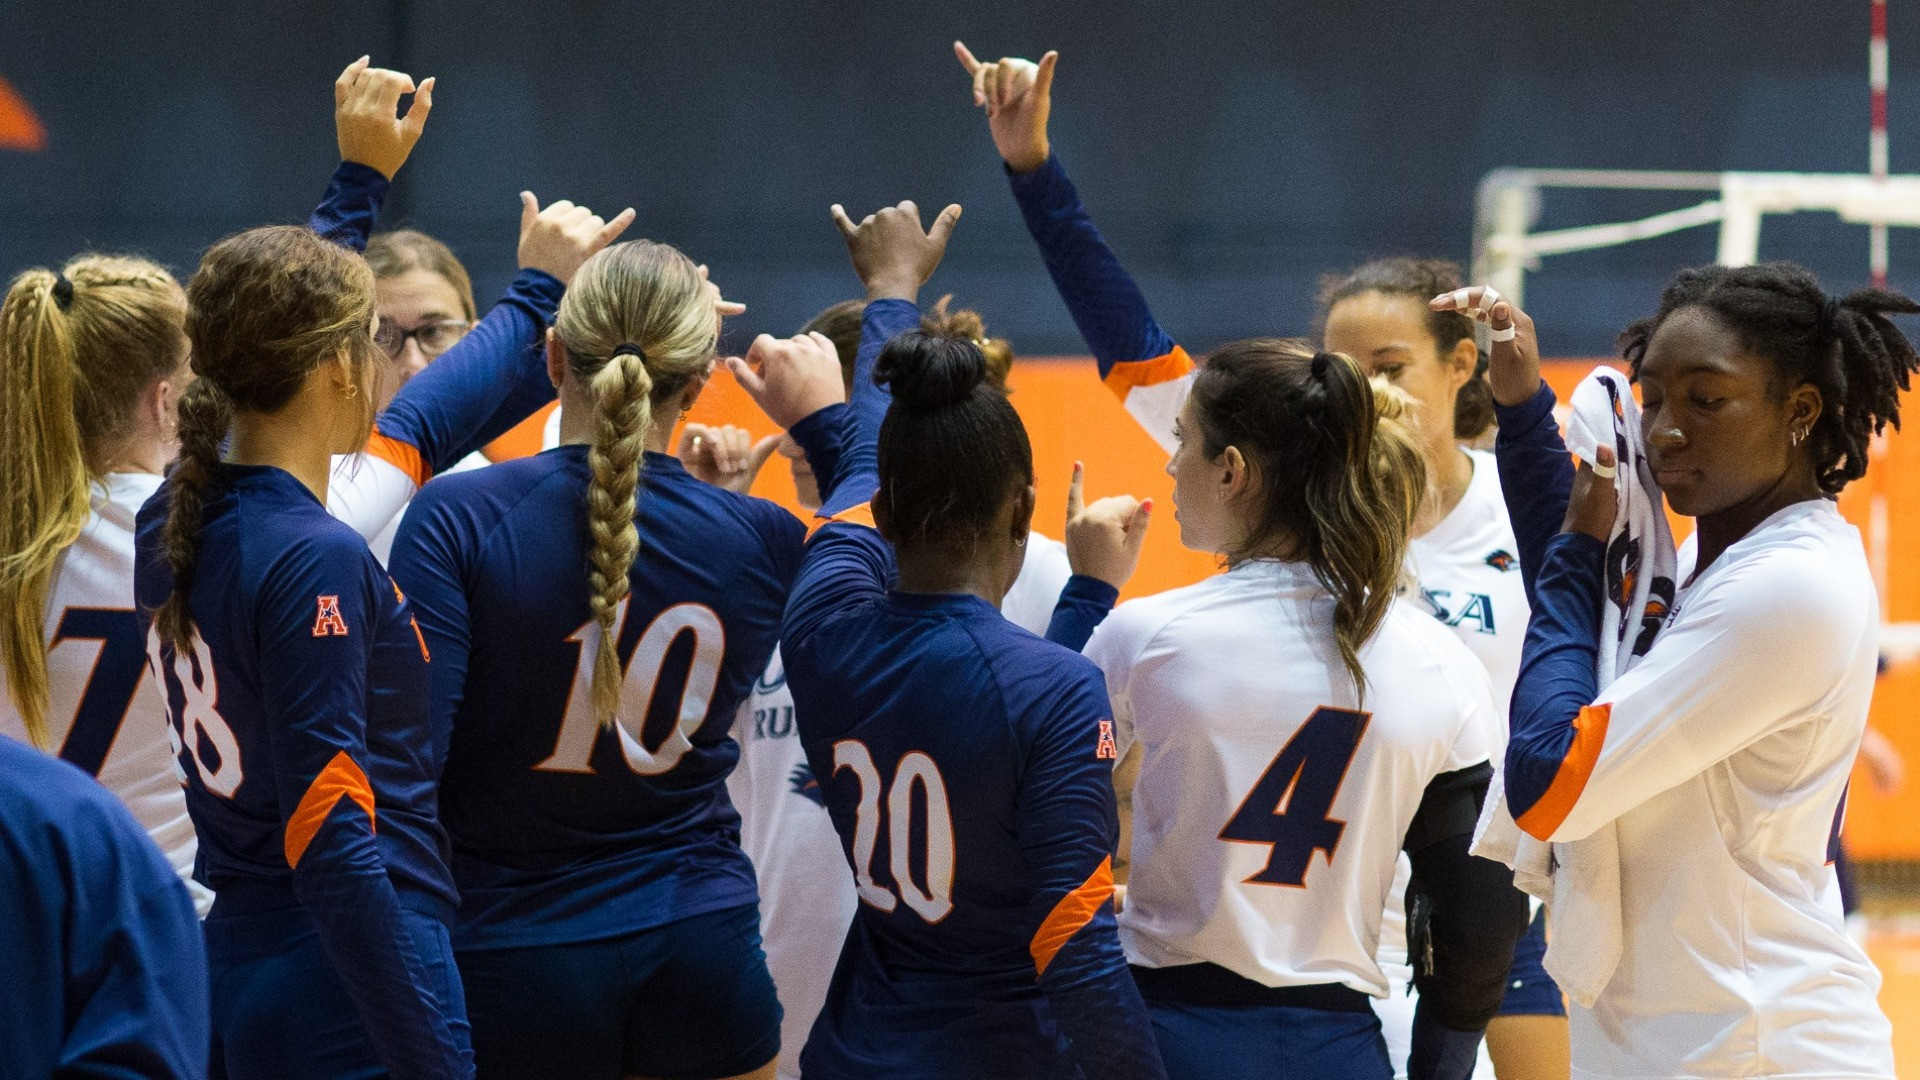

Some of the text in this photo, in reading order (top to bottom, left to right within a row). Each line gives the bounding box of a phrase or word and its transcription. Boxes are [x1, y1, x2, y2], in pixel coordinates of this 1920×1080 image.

[530, 592, 726, 776] 10
[832, 739, 956, 925] 20
[1216, 705, 1373, 889] 4
